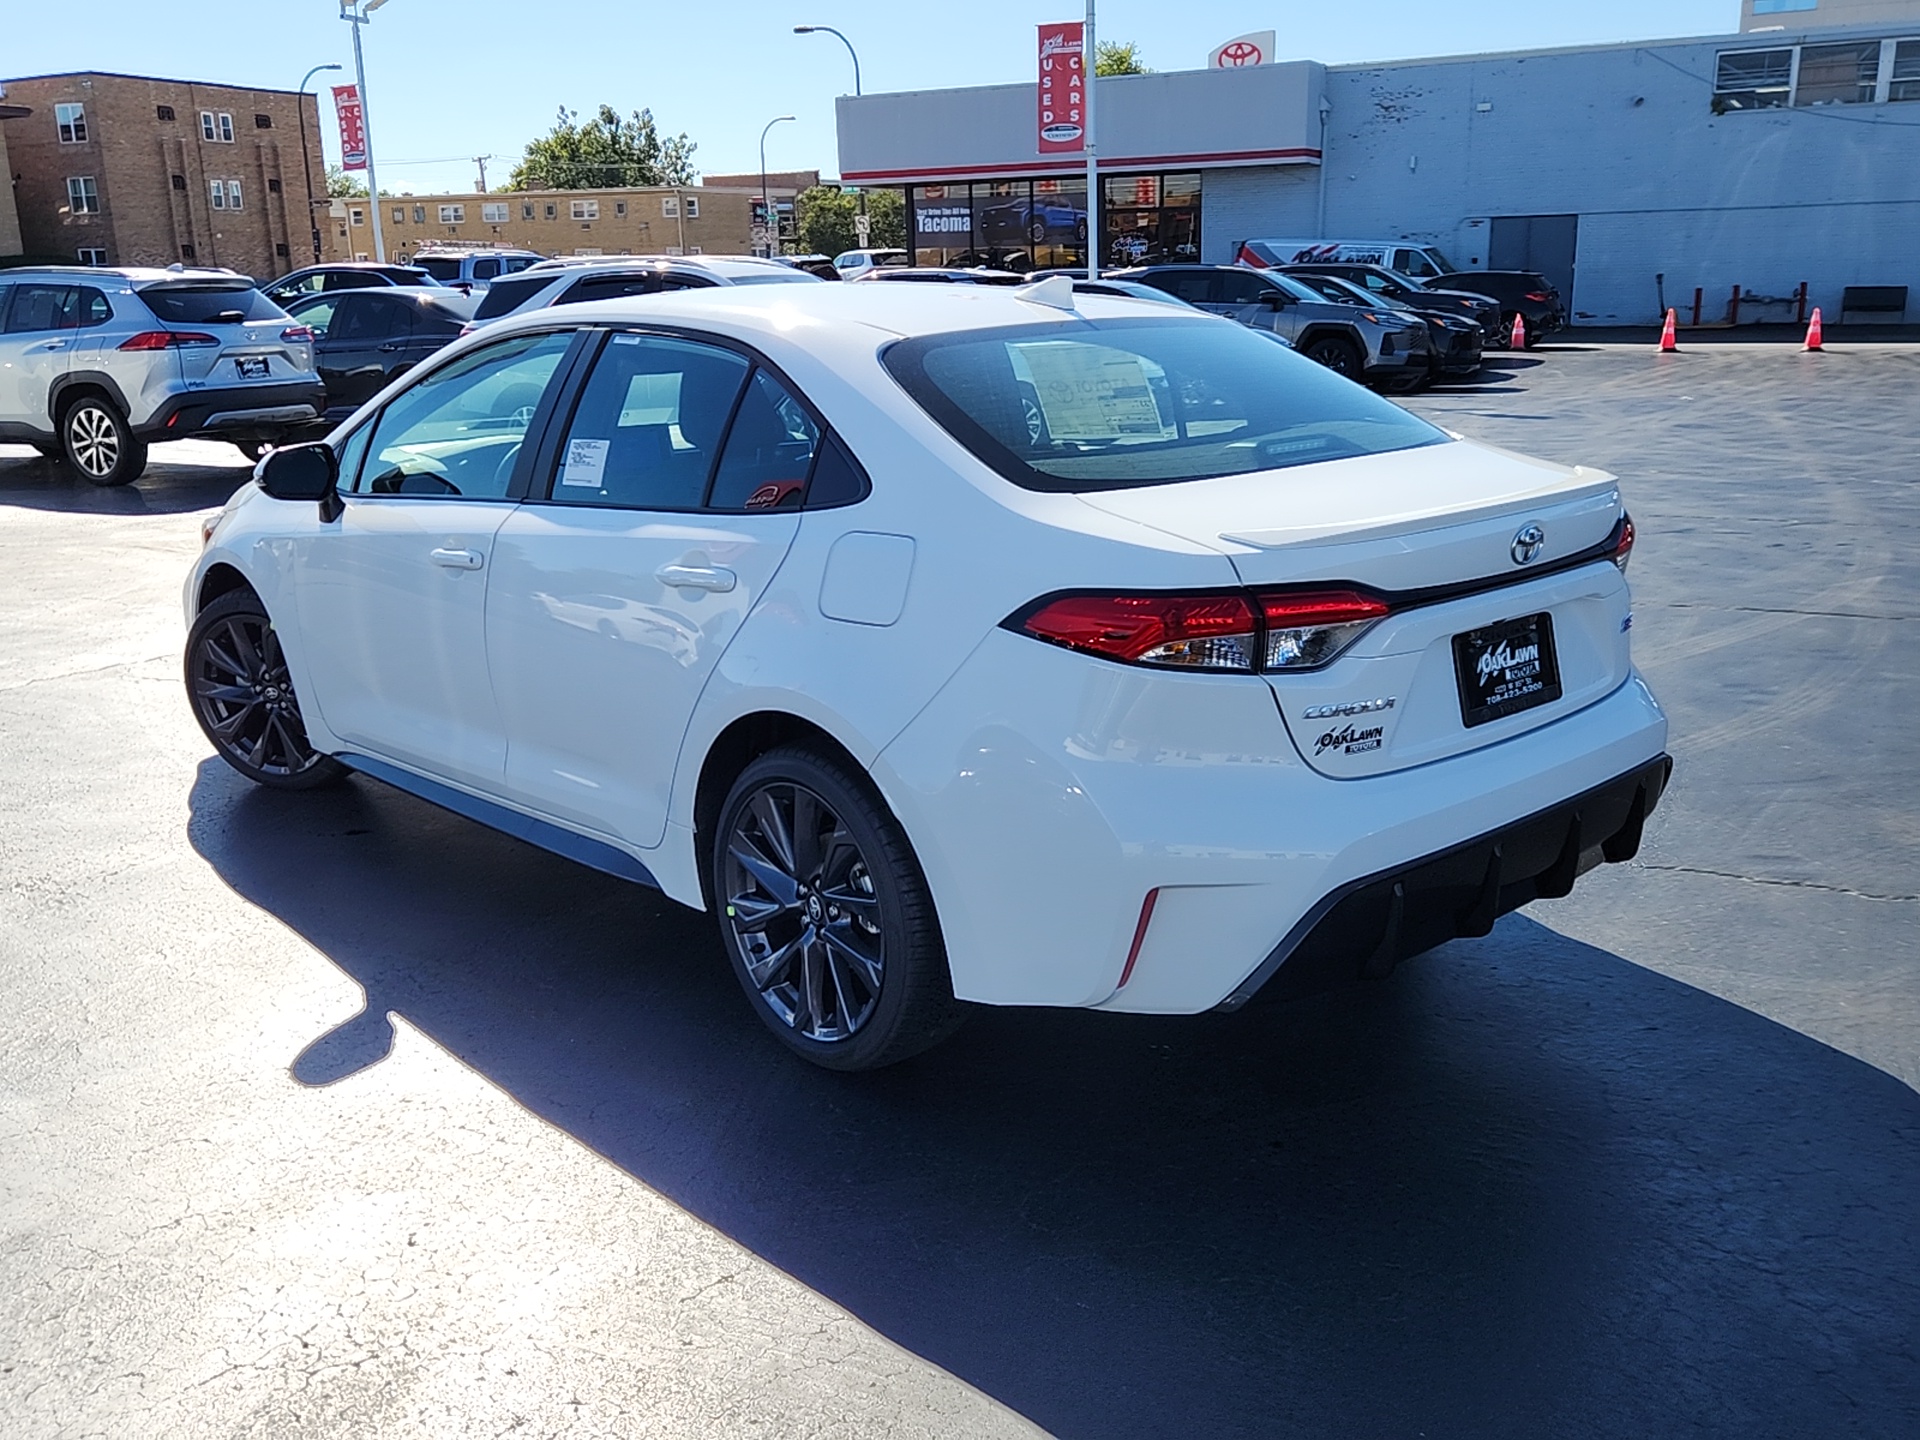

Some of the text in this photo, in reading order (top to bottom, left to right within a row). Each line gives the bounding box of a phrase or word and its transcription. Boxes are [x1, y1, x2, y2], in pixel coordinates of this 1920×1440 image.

[1042, 59, 1054, 123] USED
[1069, 57, 1081, 122] CARS
[339, 108, 351, 152] USED
[917, 215, 972, 233] Tacoma
[1303, 695, 1397, 719] COROLLA
[1348, 741, 1378, 752] TOYOTA
